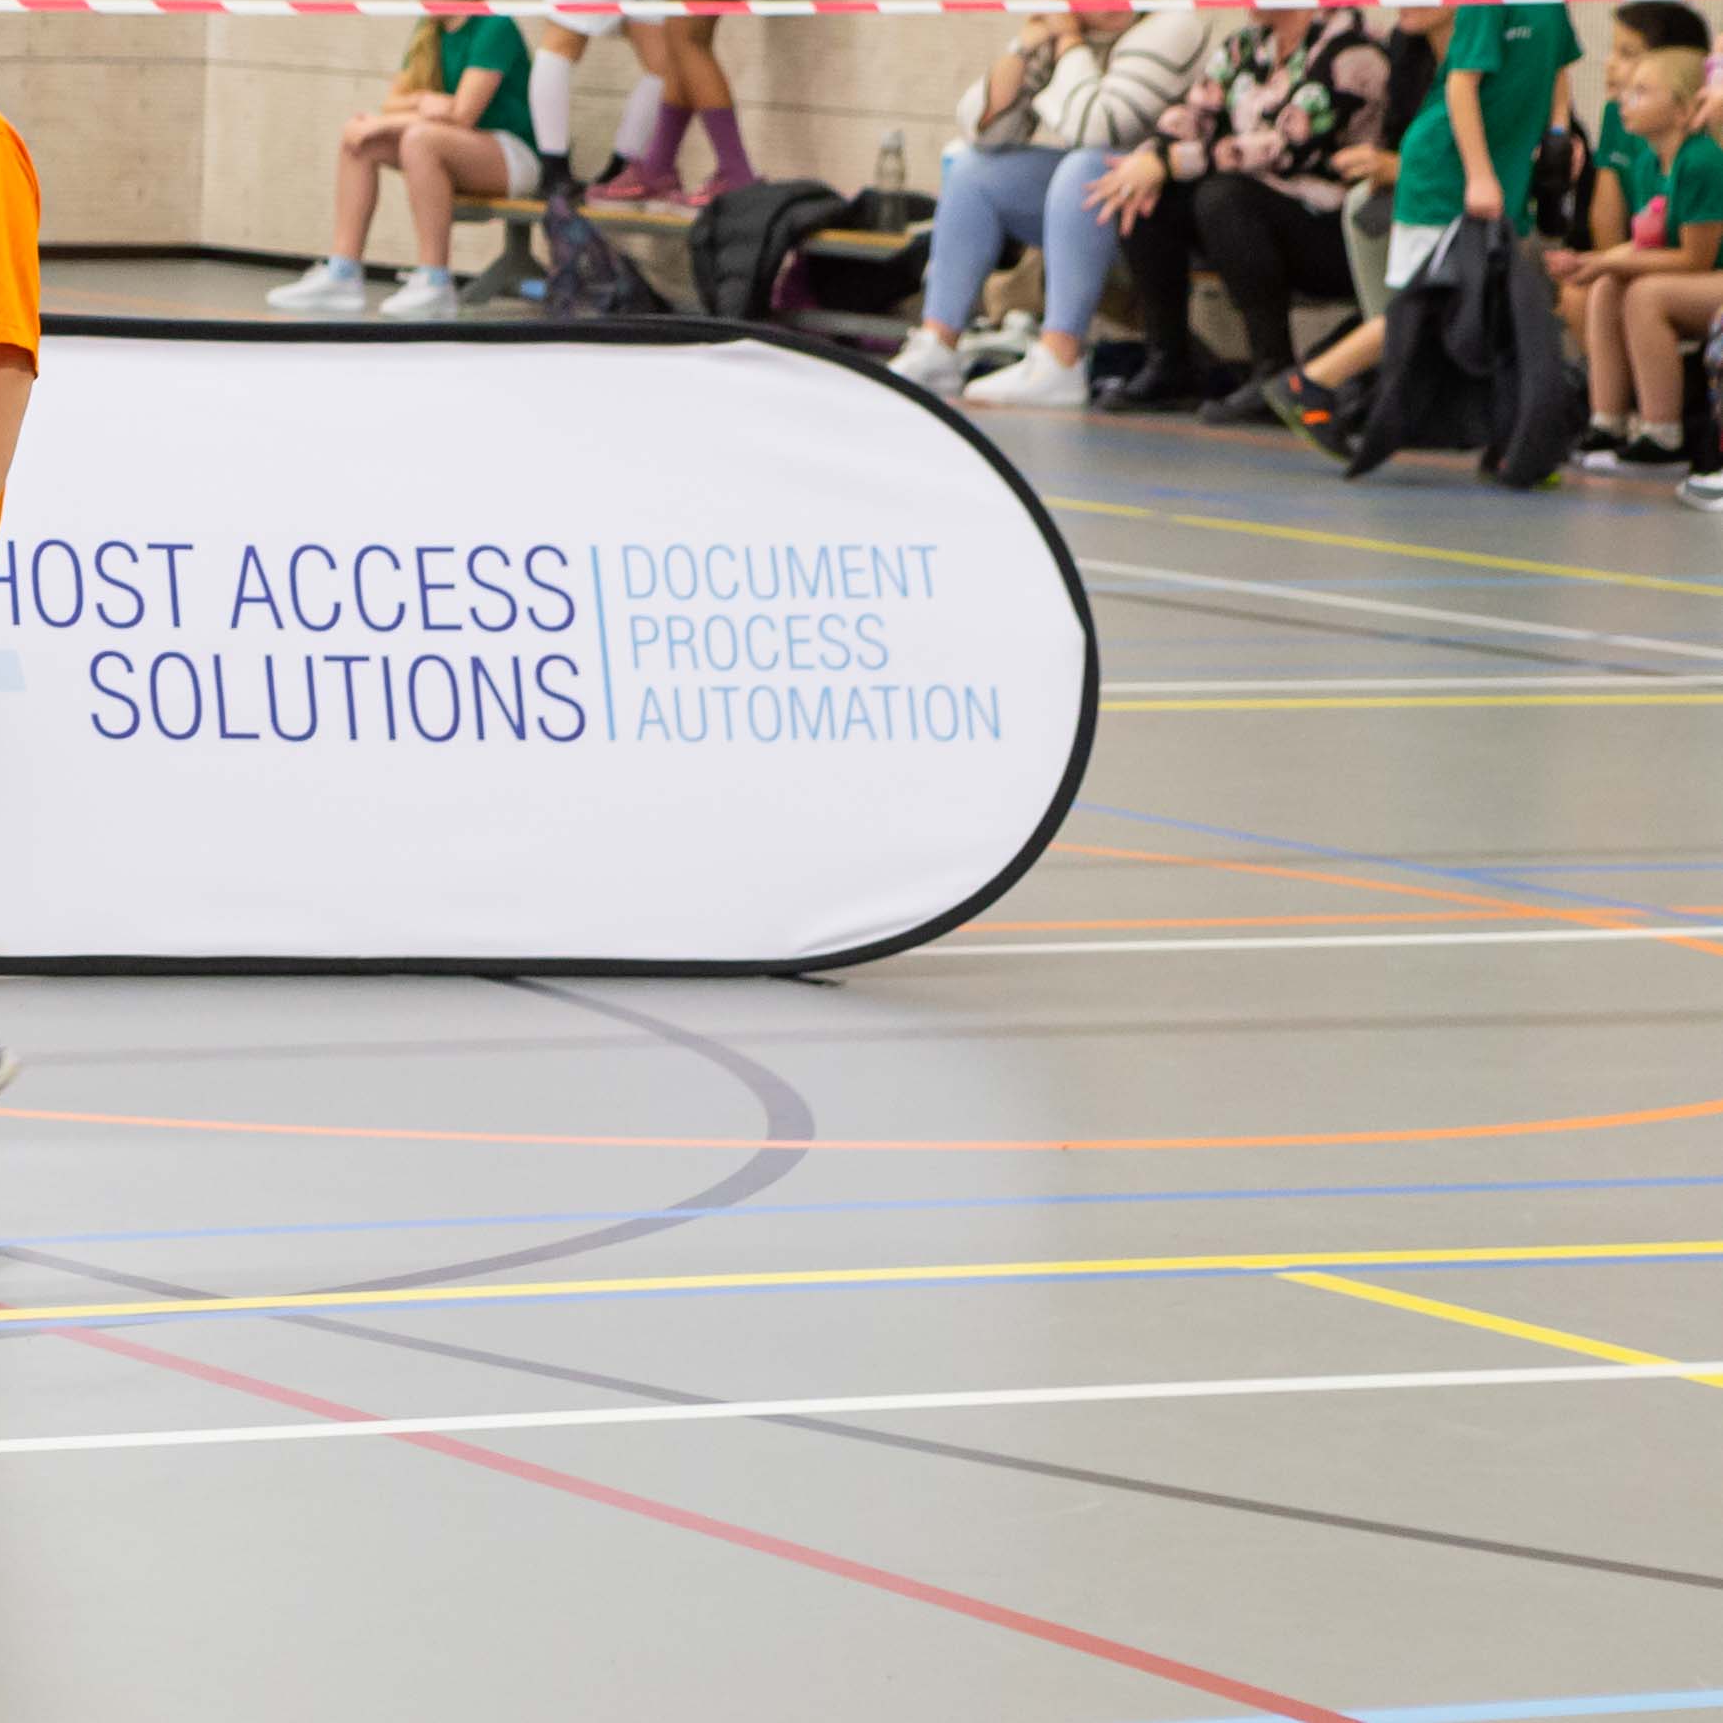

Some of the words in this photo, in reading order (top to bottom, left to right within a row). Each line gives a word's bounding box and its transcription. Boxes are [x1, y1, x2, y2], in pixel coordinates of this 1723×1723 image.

[230, 543, 576, 633] ACCESS
[621, 543, 938, 601] DOCUMENT
[629, 612, 890, 672] PROCESS
[89, 649, 587, 743] SOLUTIONS
[636, 683, 1002, 742] AUTOMATION
